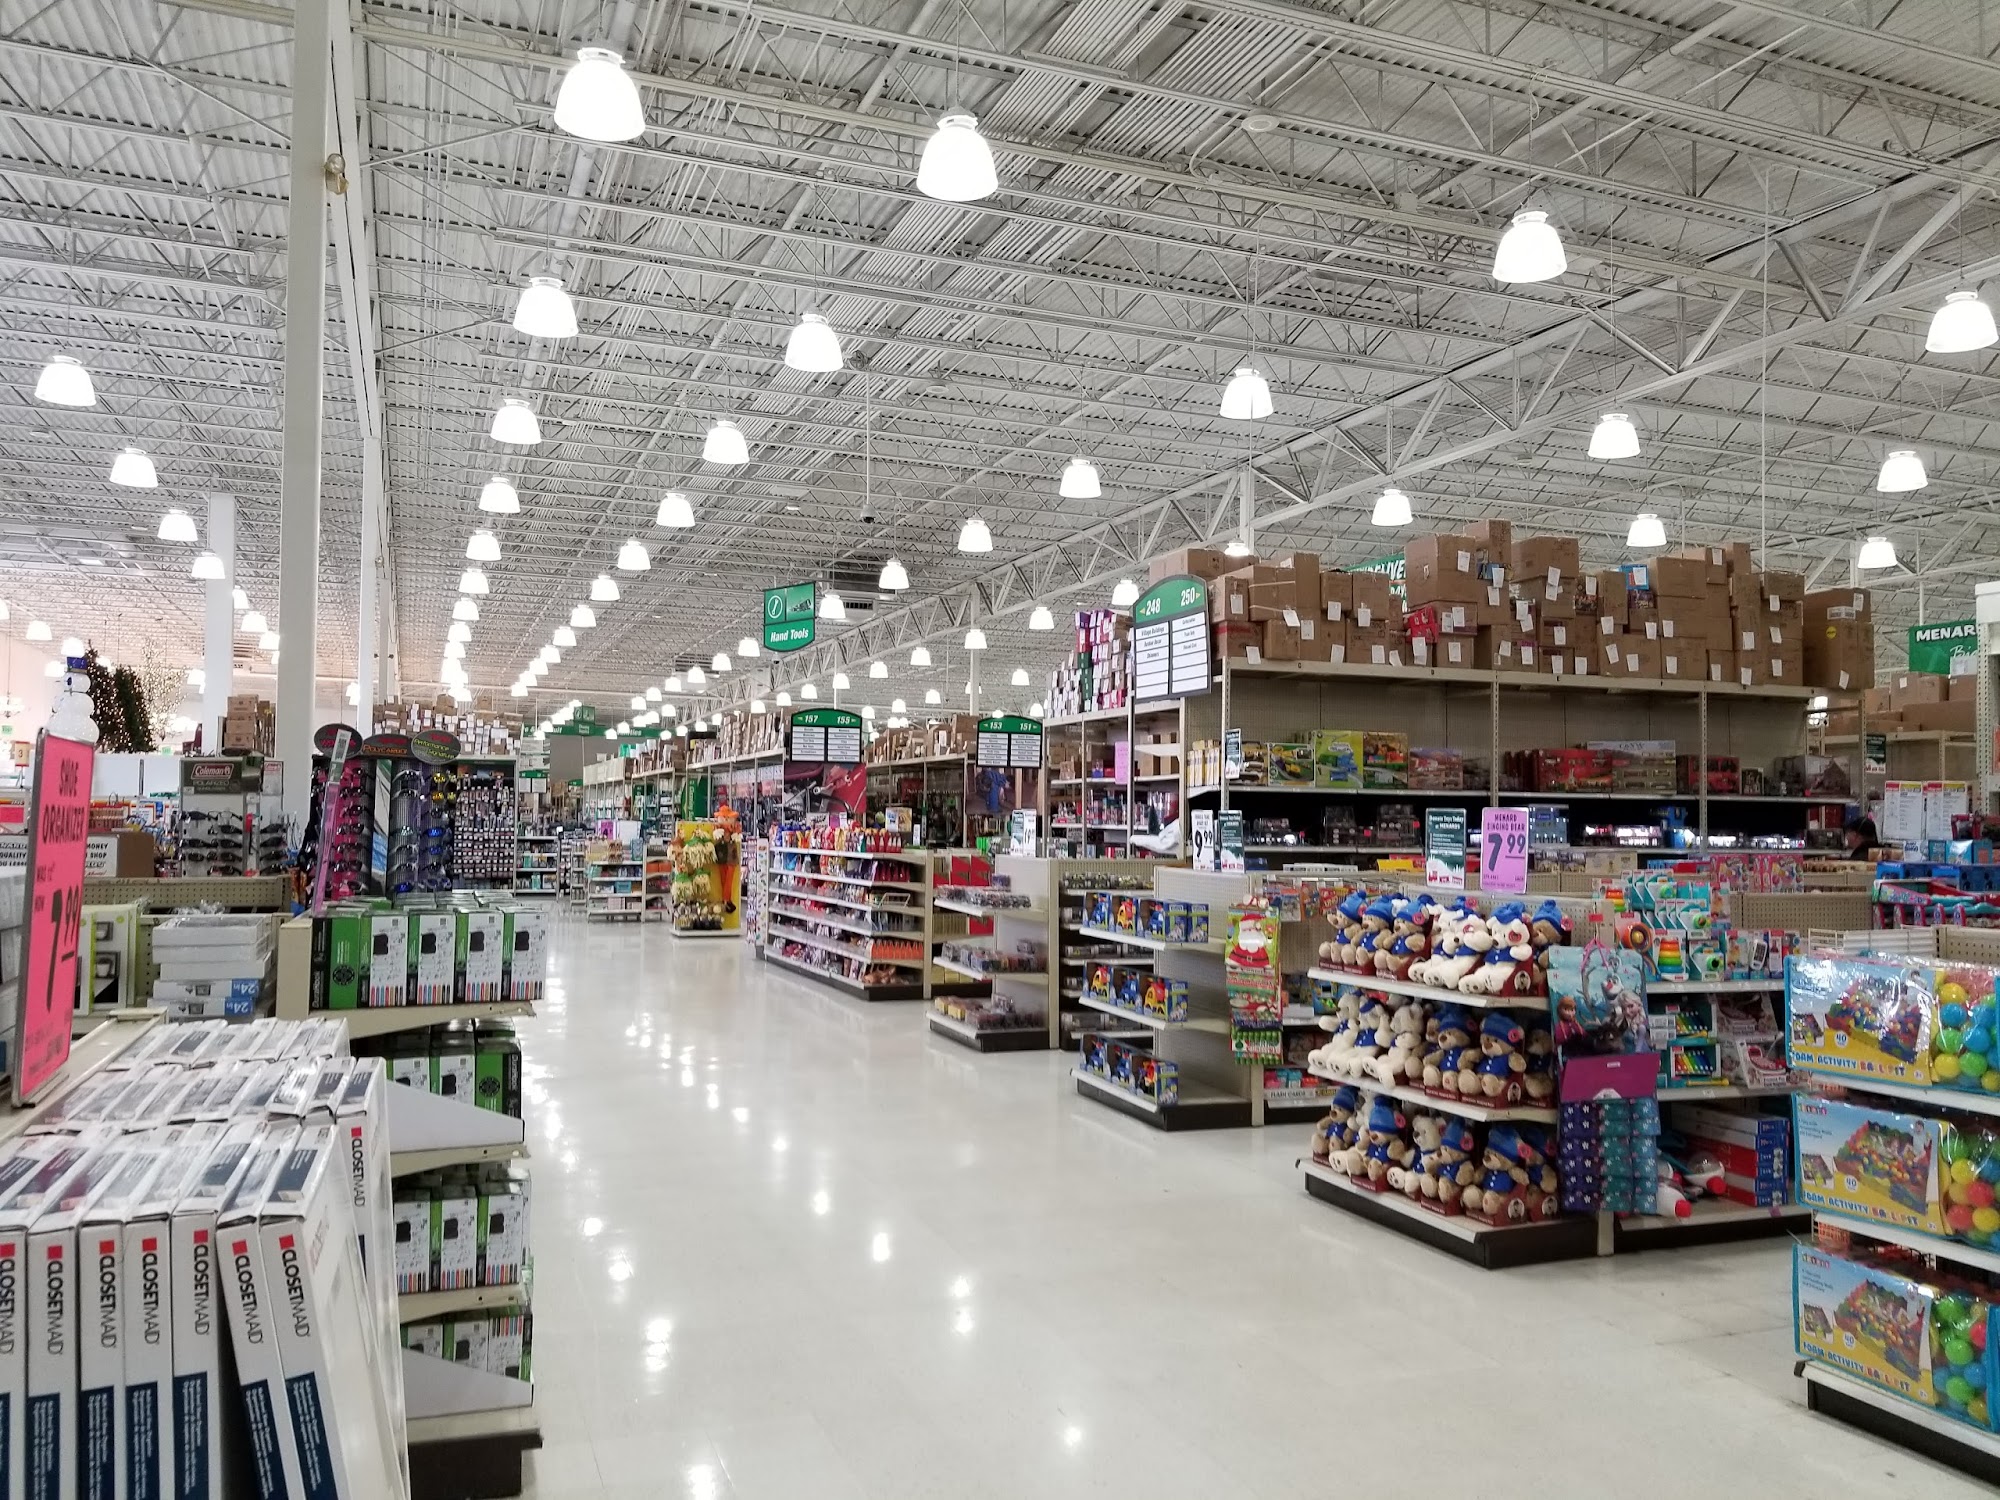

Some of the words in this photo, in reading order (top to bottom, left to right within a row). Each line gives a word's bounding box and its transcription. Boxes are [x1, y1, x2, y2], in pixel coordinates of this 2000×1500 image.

[1180, 587, 1196, 607] 250
[1146, 598, 1160, 616] 248
[770, 630, 788, 642] Hand
[790, 628, 808, 640] Tools
[805, 715, 818, 724] 157
[837, 716, 850, 724] 155
[990, 722, 1002, 730] 153
[1020, 722, 1032, 731] 151
[414, 738, 450, 750] Performance
[195, 765, 224, 776] Coleman
[59, 758, 80, 798] SHOE
[42, 804, 84, 844] ORGANIZER
[1494, 814, 1517, 822] MENARD
[1510, 824, 1525, 832] BEAR
[1195, 830, 1202, 858] 9
[1204, 830, 1212, 845] 99
[1488, 832, 1502, 872] 7
[1507, 832, 1526, 854] 99
[46, 889, 62, 1013] 7
[64, 884, 80, 946] 99
[241, 982, 256, 994] 24
[234, 1002, 249, 1013] 24
[1836, 1034, 1847, 1042] 40
[1818, 1055, 1857, 1069] ACTIVITY
[1846, 1178, 1857, 1188] 40
[1828, 1198, 1870, 1214] ACTIVITY
[1844, 1334, 1854, 1344] 40
[1804, 1341, 1825, 1358] FOAM
[1828, 1351, 1864, 1373] ACTIVITY
